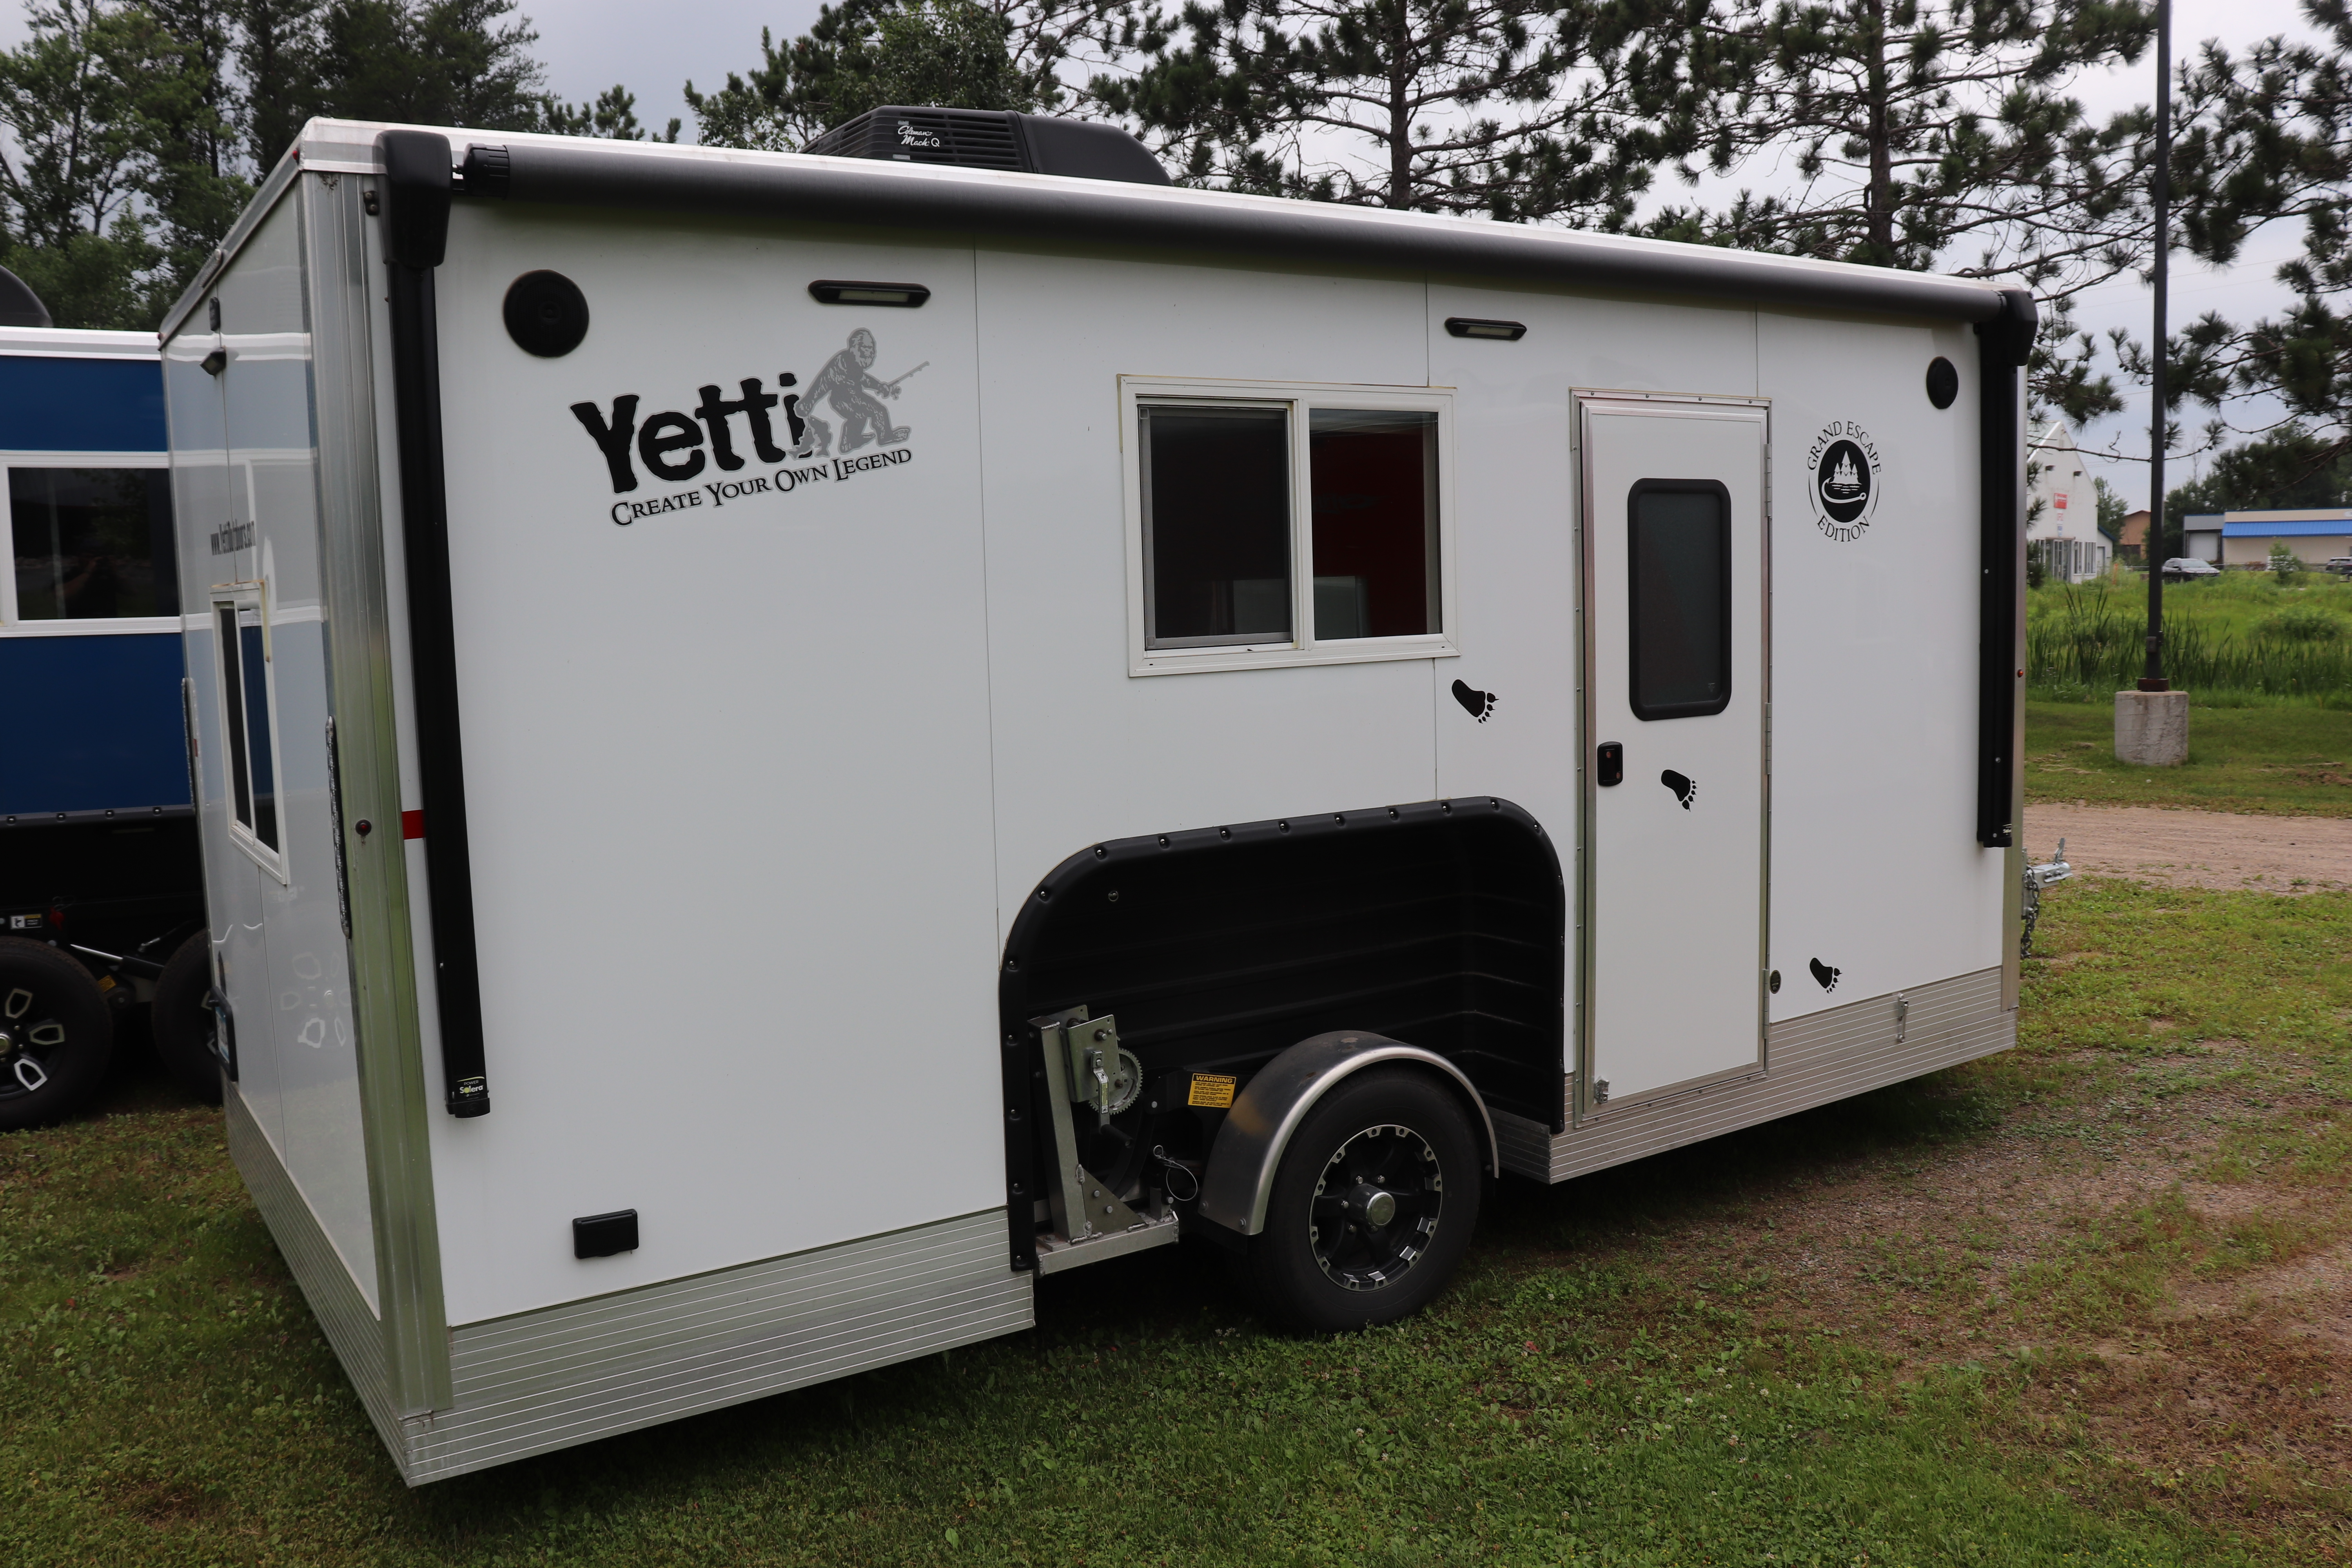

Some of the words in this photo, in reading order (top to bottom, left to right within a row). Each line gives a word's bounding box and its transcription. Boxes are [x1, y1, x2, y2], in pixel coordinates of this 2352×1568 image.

[898, 125, 932, 136] Coleman
[901, 135, 929, 146] Mach
[931, 138, 940, 147] Q
[570, 372, 812, 493] Yetti
[1808, 421, 1842, 470] GRAND
[1846, 421, 1881, 475] ESCAPE
[1817, 515, 1870, 542] EDITION
[459, 1085, 483, 1093] Solera
